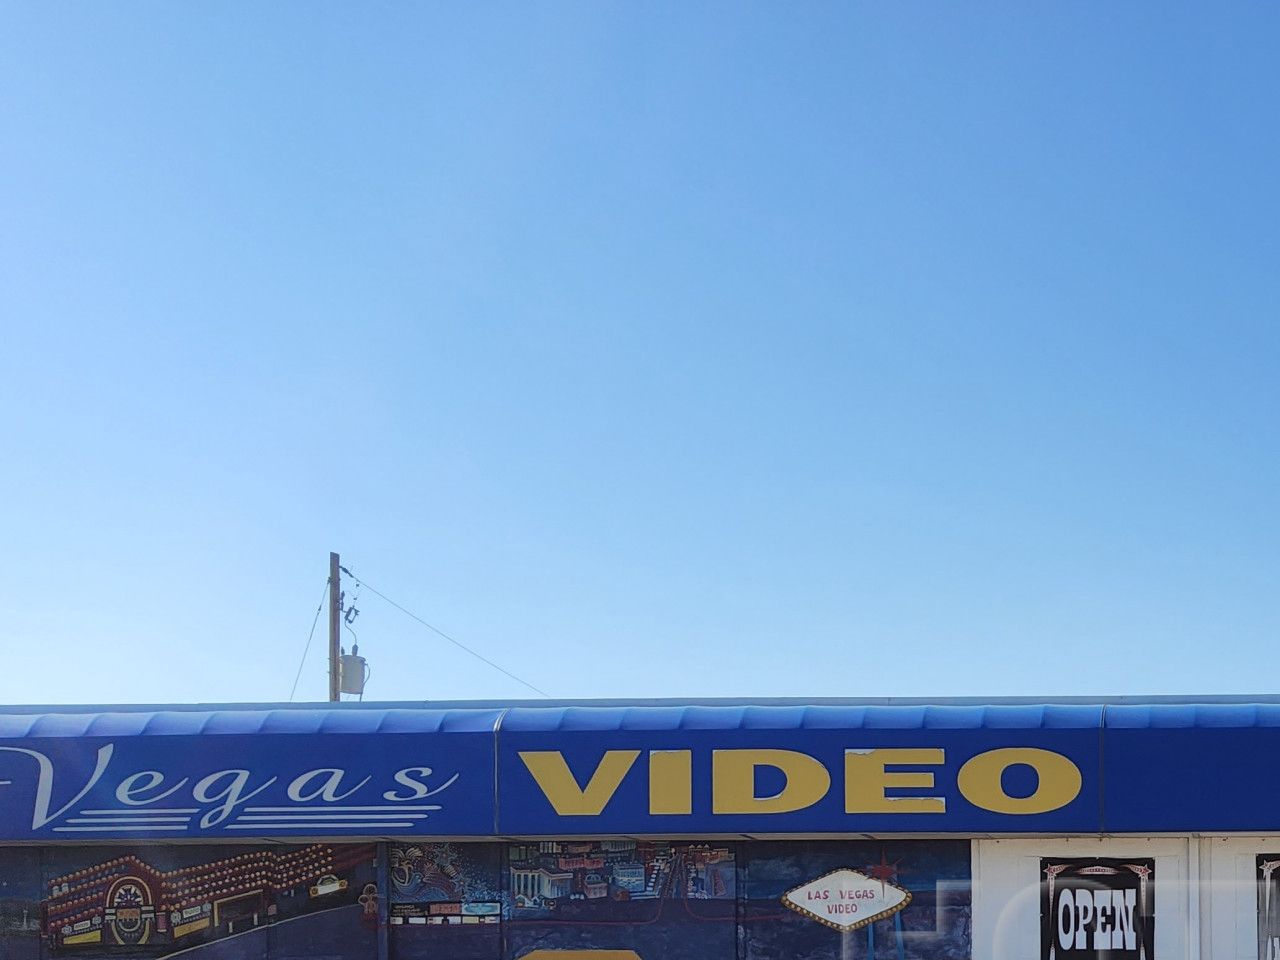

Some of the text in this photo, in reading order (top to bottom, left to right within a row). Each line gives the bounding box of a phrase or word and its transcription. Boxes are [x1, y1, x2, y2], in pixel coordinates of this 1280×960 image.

[0, 743, 459, 830] Vegas
[518, 748, 1082, 816] VIDEO
[807, 889, 875, 900] LAS VEGAS
[827, 903, 858, 914] VIDEO
[1058, 888, 1136, 950] OPEN
